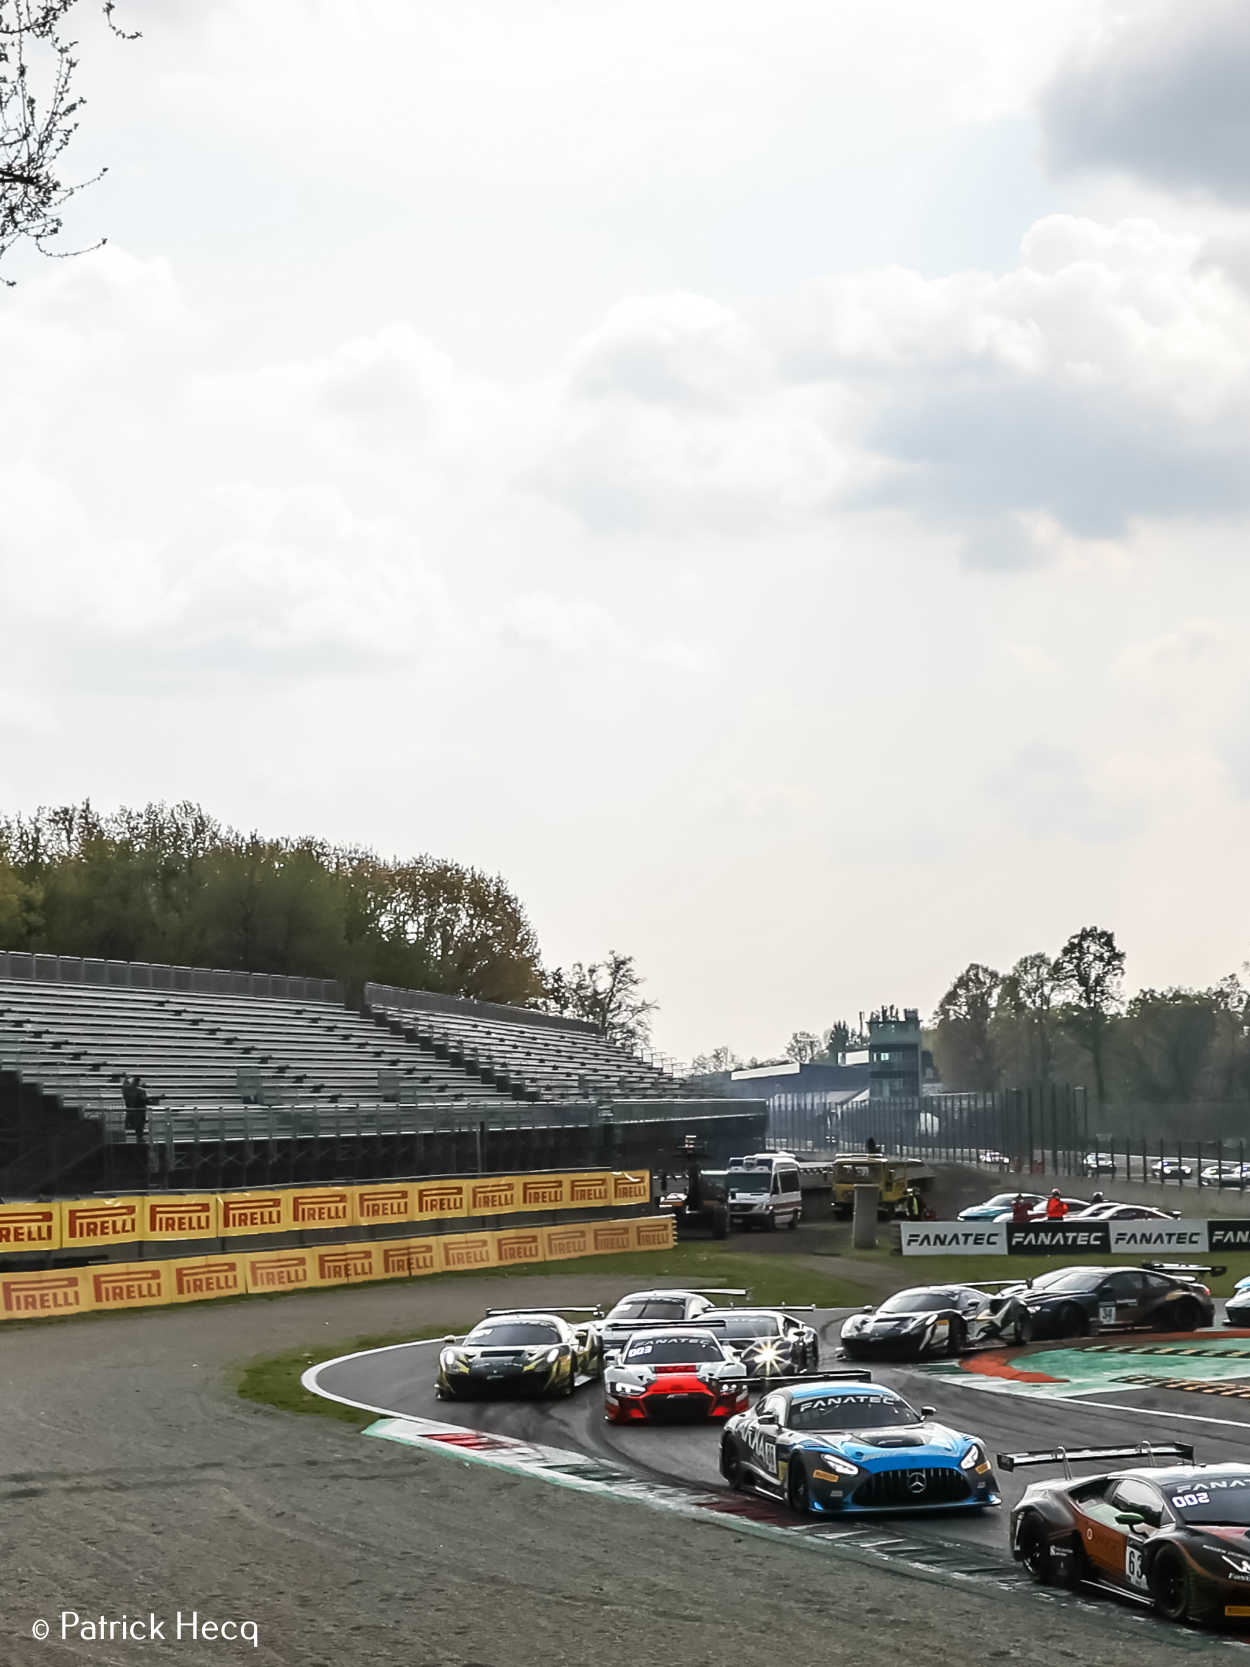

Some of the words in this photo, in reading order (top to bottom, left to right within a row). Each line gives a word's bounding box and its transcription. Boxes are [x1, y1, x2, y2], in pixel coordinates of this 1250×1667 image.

[419, 1186, 463, 1213] PIRELLI
[472, 1182, 514, 1209] PIRELLI
[523, 1180, 563, 1204] PIRELLI
[570, 1178, 607, 1201] PIRELLI
[614, 1176, 646, 1199] PIRELLI
[223, 1198, 281, 1228] PIRELLI
[293, 1194, 346, 1222] PIRELLI
[359, 1190, 408, 1217] PIRELLI
[68, 1205, 136, 1238] PIRELLI
[150, 1203, 210, 1232] PIRELLI
[496, 1235, 539, 1261] PIRELLI
[547, 1230, 586, 1255] PIRELLI
[593, 1227, 629, 1250] PIRELLI
[636, 1224, 669, 1246] PIRELLI
[906, 1232, 1000, 1247] FANATEC
[1011, 1231, 1105, 1246] FANATEC
[1114, 1232, 1200, 1245] FANATEC
[318, 1250, 372, 1279] PIRELLI
[383, 1245, 433, 1273] PIRELLI
[443, 1239, 489, 1266] PIRELLI
[175, 1262, 238, 1295] PIRELLI
[250, 1257, 307, 1286] PIRELLI
[2, 1277, 79, 1311] PIRELLI
[93, 1270, 161, 1303] PIRELLI
[628, 1345, 653, 1358] 003
[634, 1338, 710, 1348] FANATEC
[800, 1395, 895, 1412] FANATEC
[1171, 1492, 1210, 1508] 002
[1128, 1550, 1144, 1580] 63
